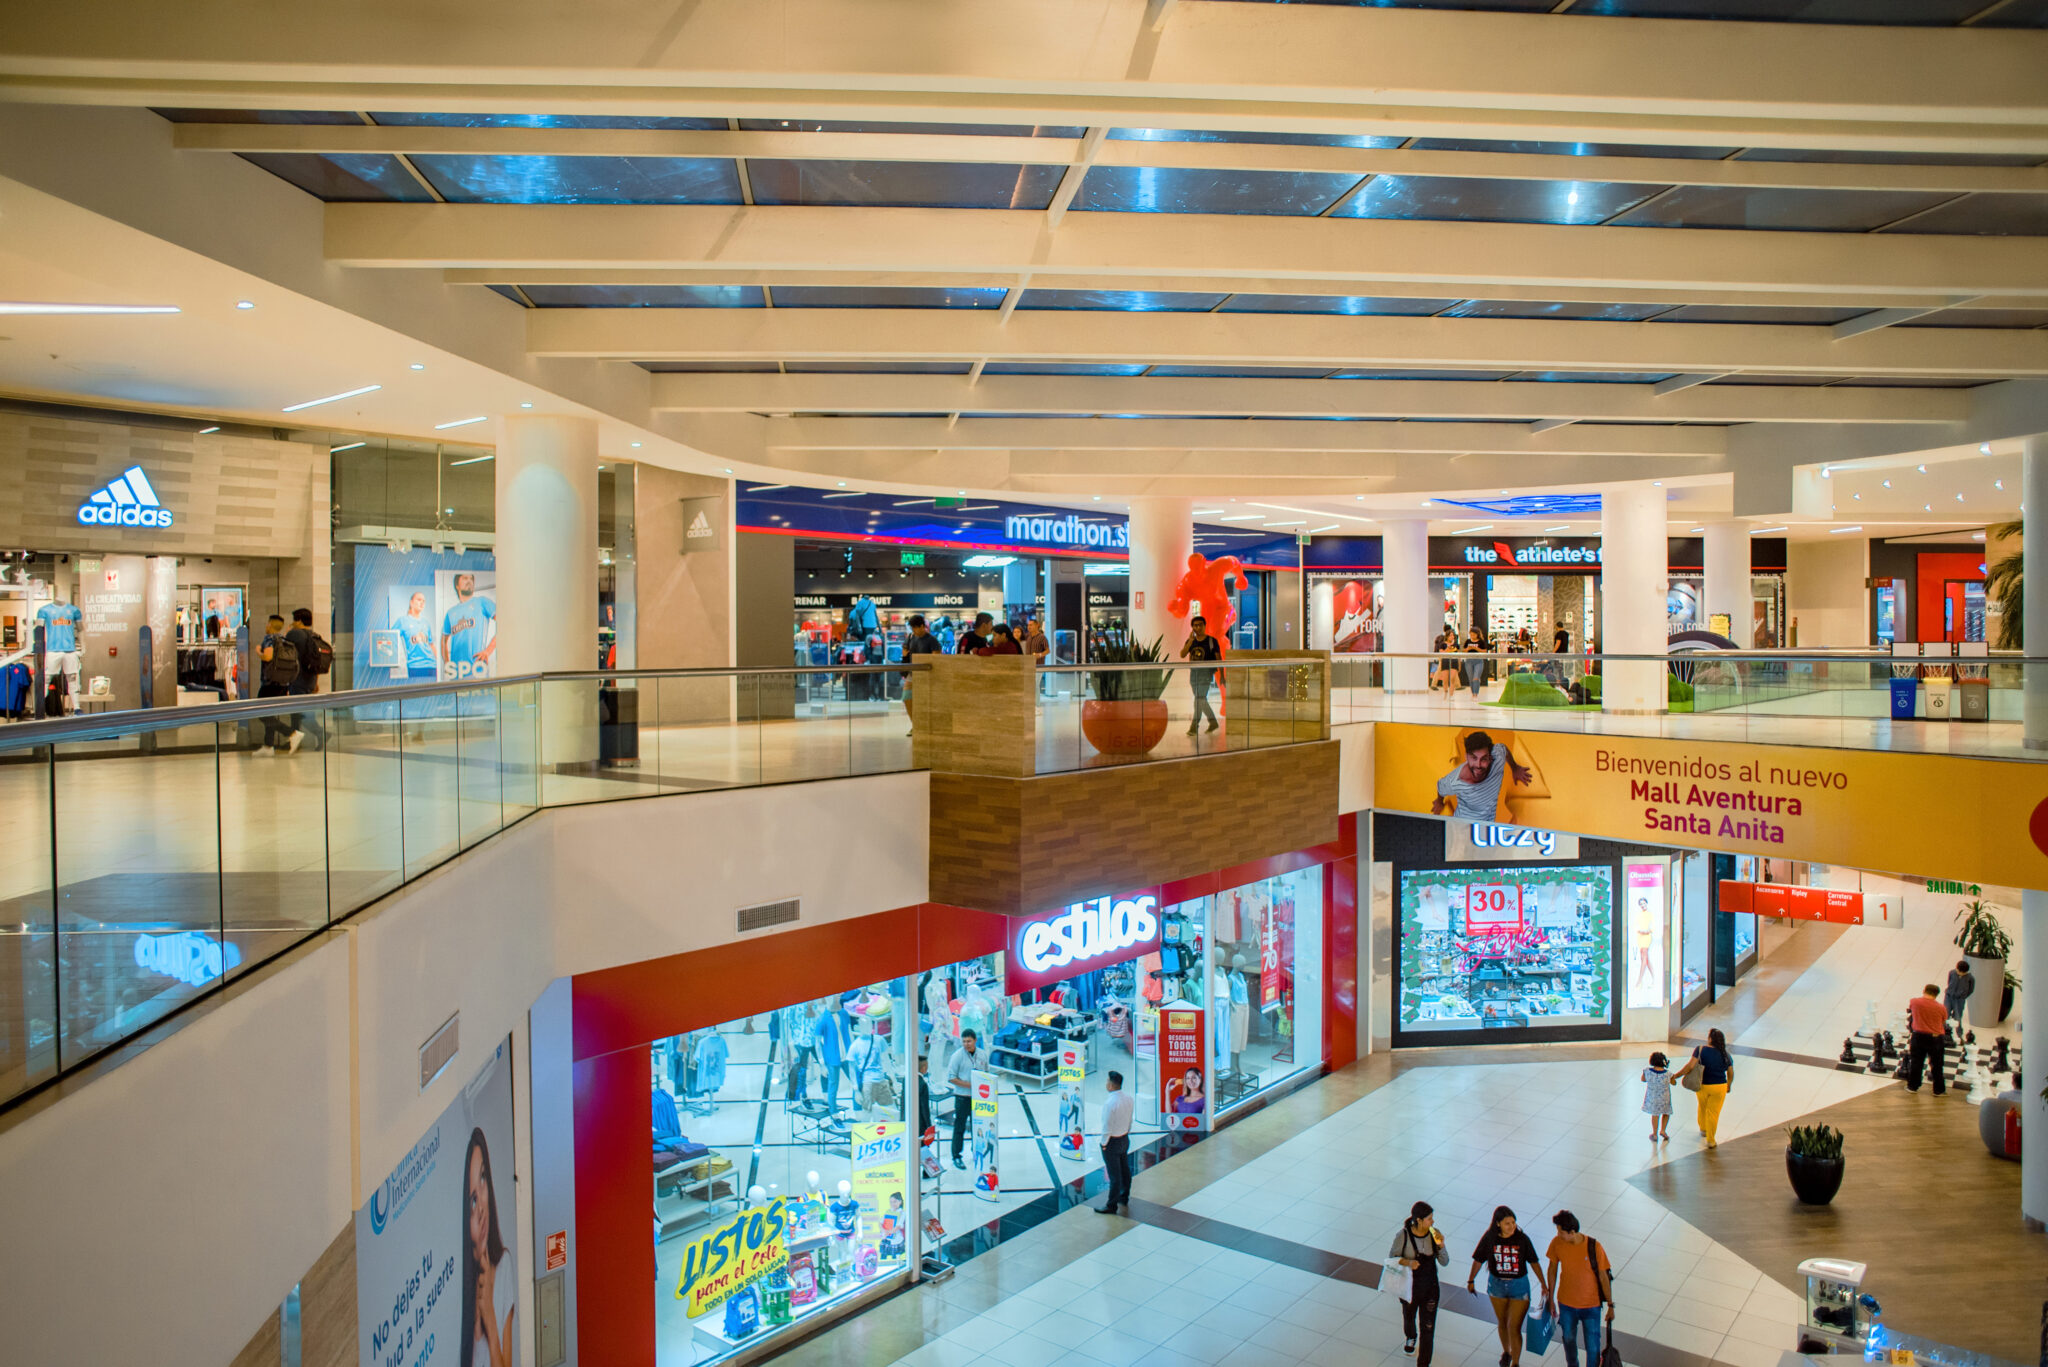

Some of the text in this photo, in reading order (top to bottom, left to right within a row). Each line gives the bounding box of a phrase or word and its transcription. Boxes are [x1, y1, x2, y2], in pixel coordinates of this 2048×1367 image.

[78, 501, 173, 527] adidas
[1465, 546, 1498, 563] the
[1515, 546, 1597, 563] athlete's
[85, 594, 95, 603] LA
[794, 597, 826, 605] TRENAR
[851, 594, 892, 605] BÁQUET
[934, 595, 963, 605] NIÑOS
[1090, 595, 1113, 603] NCHA
[1361, 619, 1384, 633] FORC
[1595, 750, 1848, 790] Bienvenidos al nuevo
[1630, 779, 1802, 816] Mall Aventura
[1645, 808, 1784, 844] Santa Anita
[1756, 886, 1785, 895] Ascensores
[1791, 889, 1808, 899] Ripley
[1827, 892, 1853, 901] Carretera
[1926, 880, 1963, 895] SALIDA
[1827, 899, 1847, 907] Central
[1879, 902, 1888, 921] 1
[1020, 895, 1158, 973] estilos
[1262, 949, 1278, 972] 70
[1169, 1041, 1197, 1050] TODOS
[975, 1102, 995, 1113] LISTOS
[857, 1137, 901, 1160] LISTOS
[392, 1127, 440, 1208] Internacional
[679, 1200, 783, 1296] LISTOS
[696, 1273, 729, 1306] para
[734, 1259, 745, 1279] el
[704, 1255, 786, 1312] TODO EN UN SOLO LUGAR
[373, 1249, 433, 1360] No dejes tu
[407, 1326, 413, 1349] a
[415, 1307, 425, 1334] la
[426, 1255, 454, 1315] suerte
